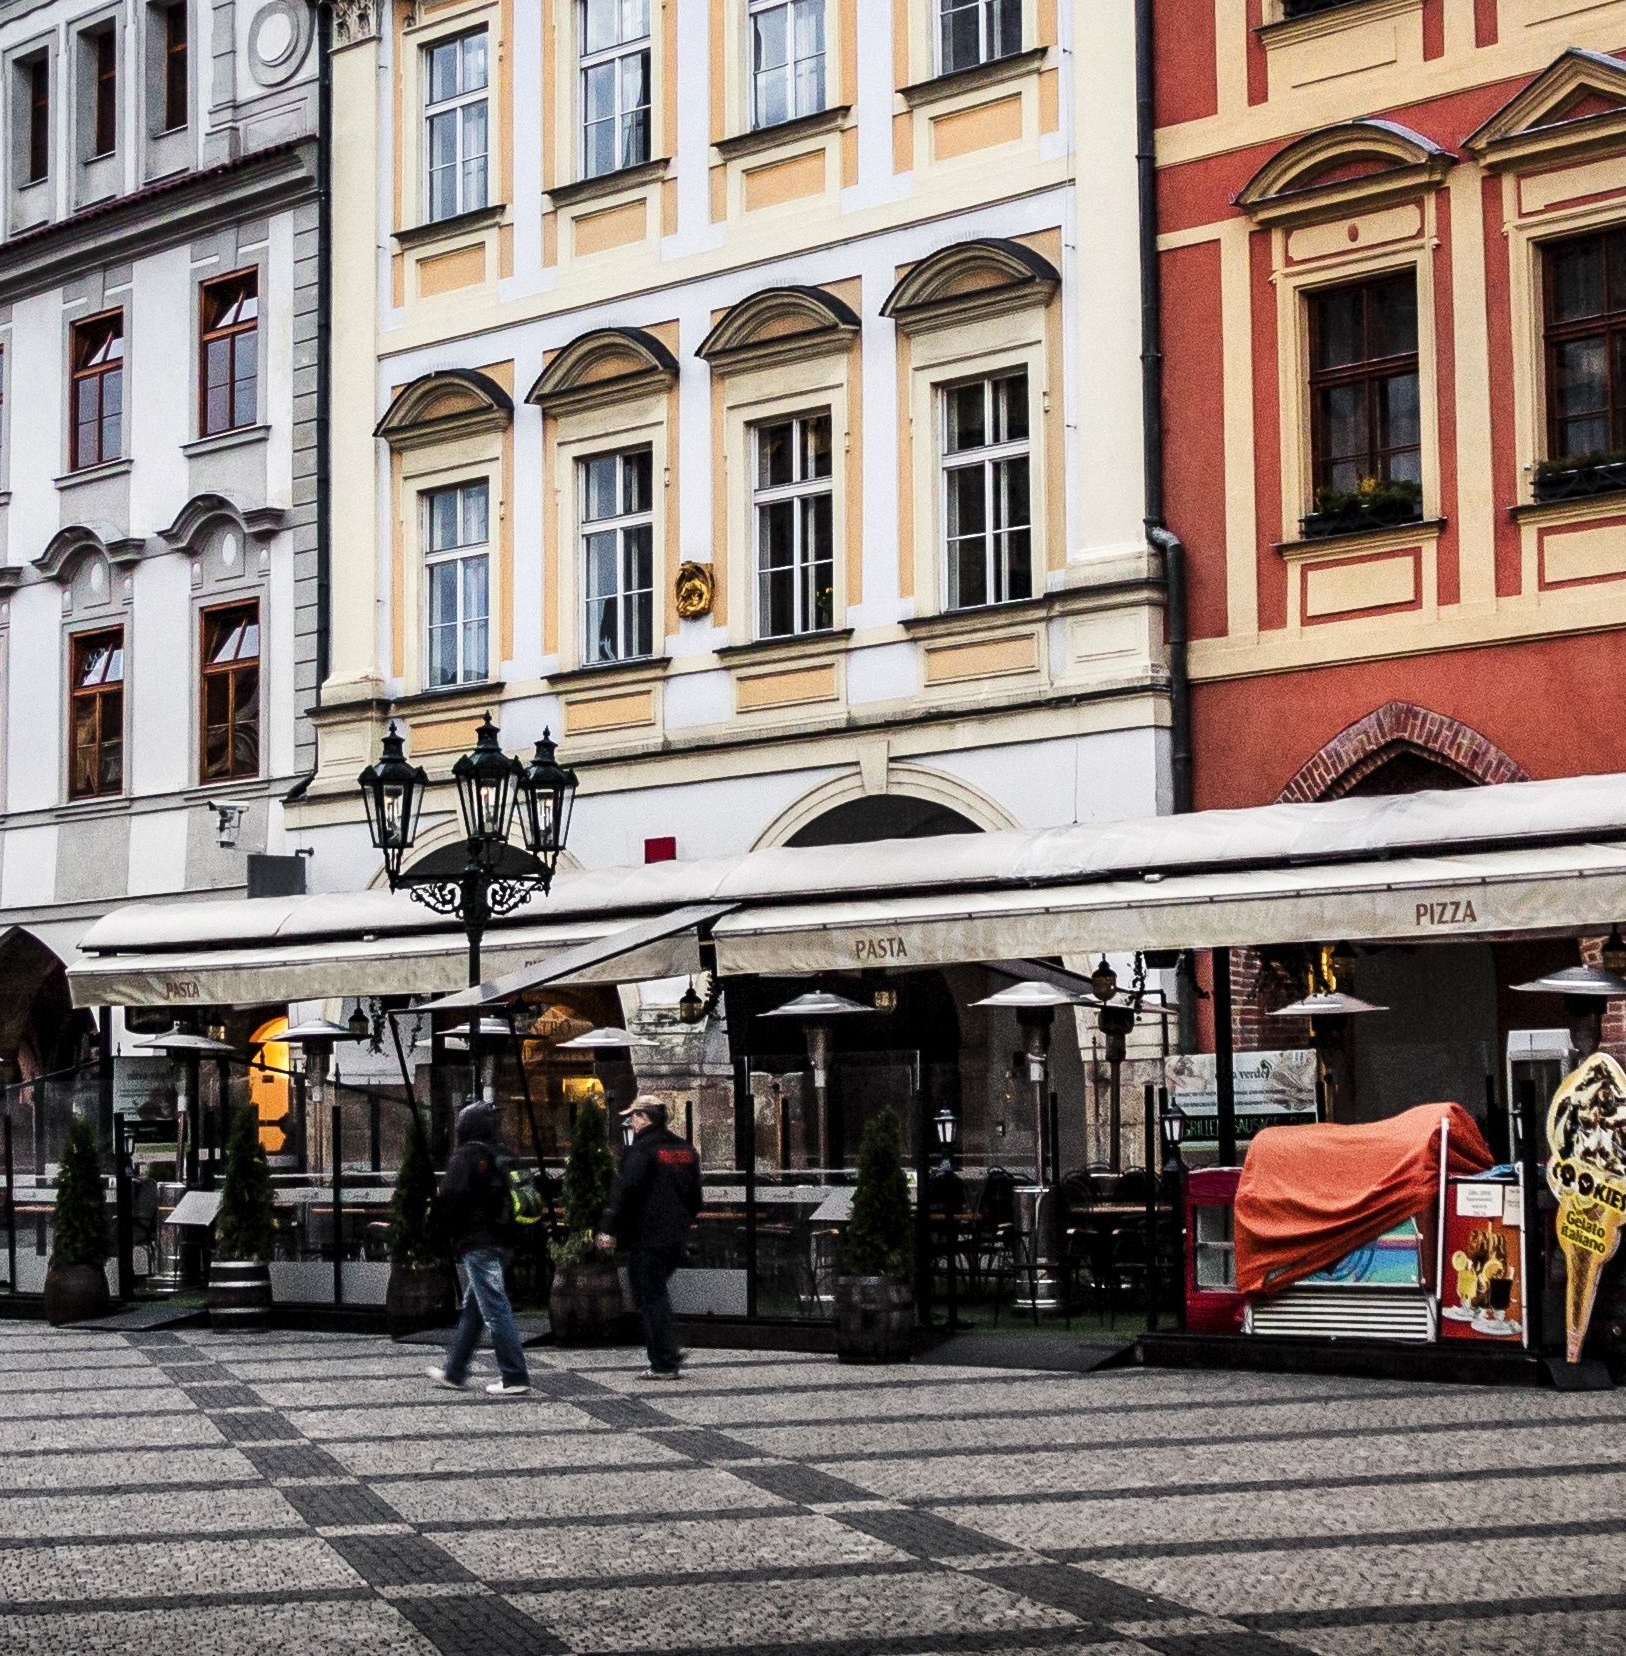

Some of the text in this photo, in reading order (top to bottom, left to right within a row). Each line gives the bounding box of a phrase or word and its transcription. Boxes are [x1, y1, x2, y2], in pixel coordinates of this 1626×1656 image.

[1415, 900, 1478, 926] PIZZA
[854, 936, 908, 960] PASTA
[165, 981, 200, 998] PASTA
[1185, 1118, 1220, 1137] GRILLE
[1566, 1210, 1606, 1239] Gelato
[1560, 1223, 1606, 1254] italiano
